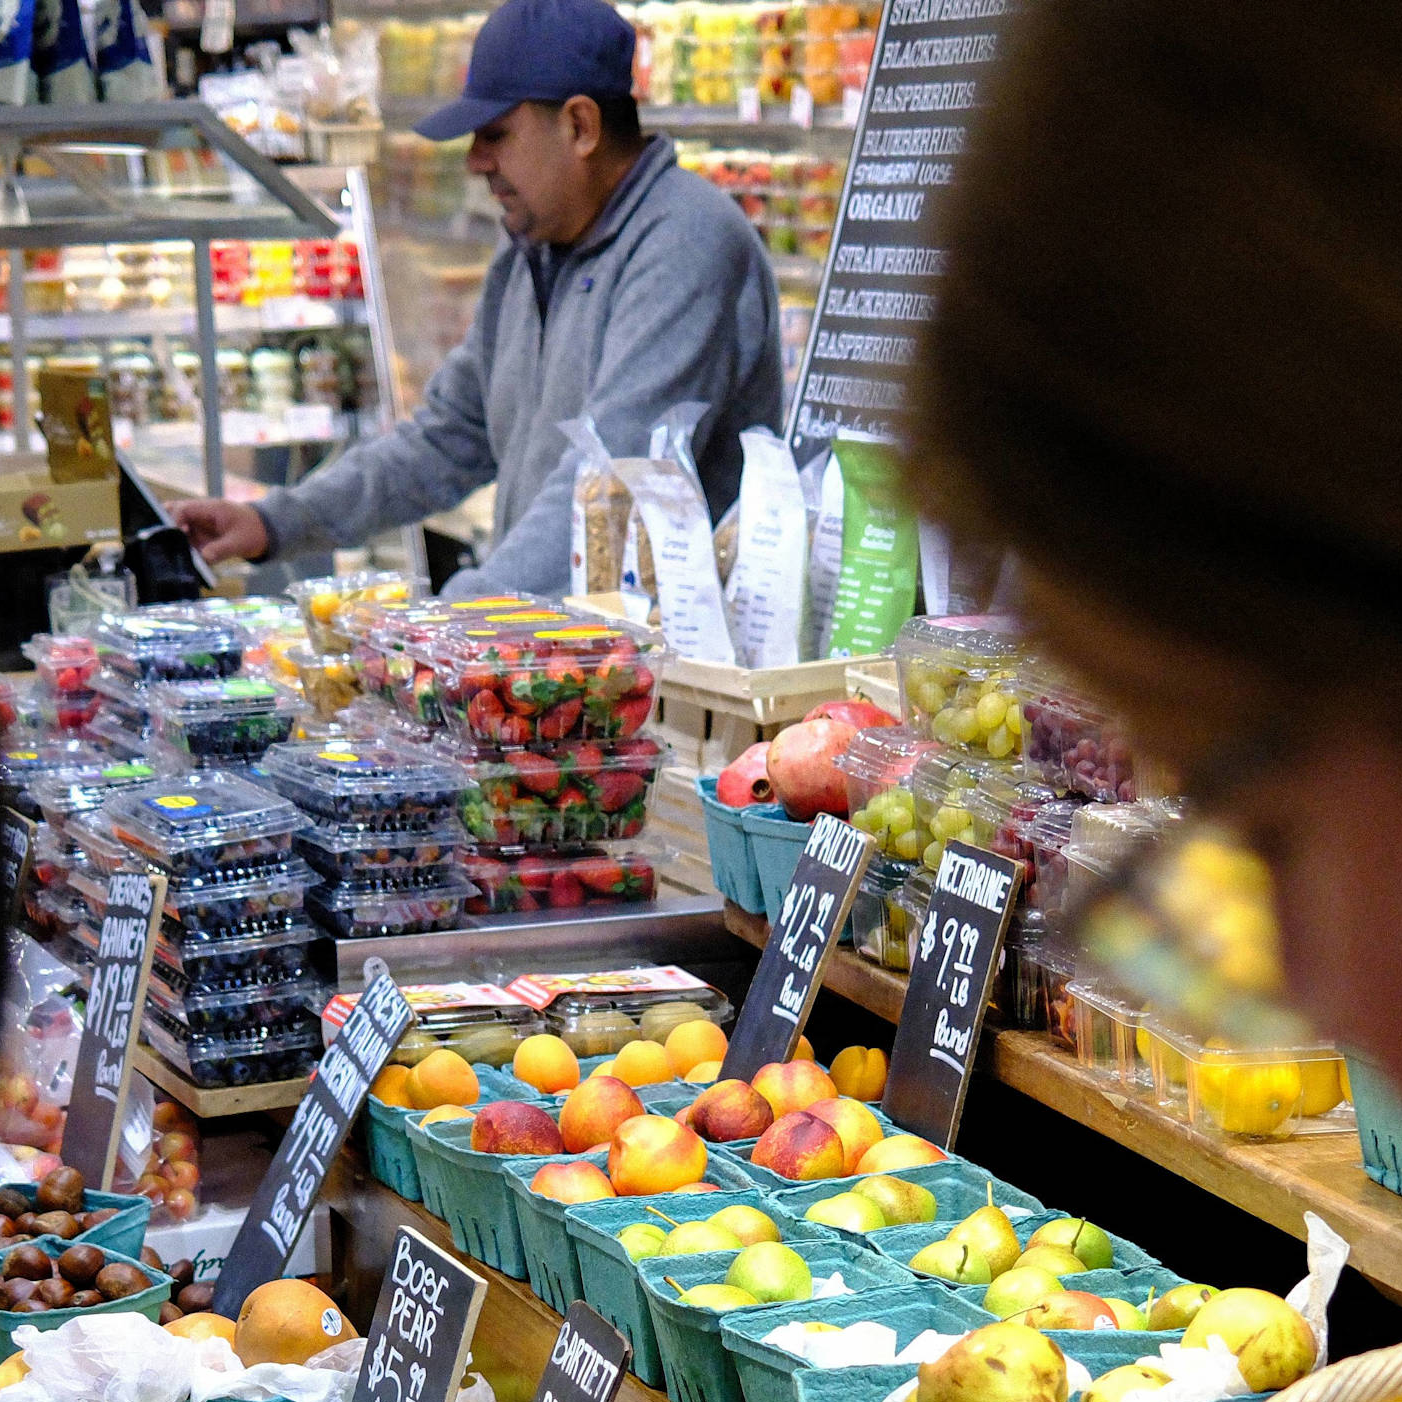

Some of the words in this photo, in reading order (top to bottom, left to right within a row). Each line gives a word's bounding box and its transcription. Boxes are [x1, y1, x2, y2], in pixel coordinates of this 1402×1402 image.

[880, 34, 997, 69] BLACKBERRIES
[870, 81, 977, 113] RASPBERRIES
[861, 126, 966, 157] BLUEBERRIES
[847, 192, 925, 222] ORGANIC
[804, 819, 866, 876] APRICOT
[107, 874, 153, 915] CHERRIES
[935, 850, 1012, 915] NECTARINE
[98, 916, 147, 962] RAINER
[364, 974, 411, 1038] FRESH
[779, 972, 808, 1015] Pound
[342, 1004, 392, 1081] ITALIAN
[933, 1008, 971, 1056] Pound
[95, 1048, 124, 1087] Pound
[391, 1236, 450, 1316] BOSC
[388, 1288, 438, 1357] PEAR
